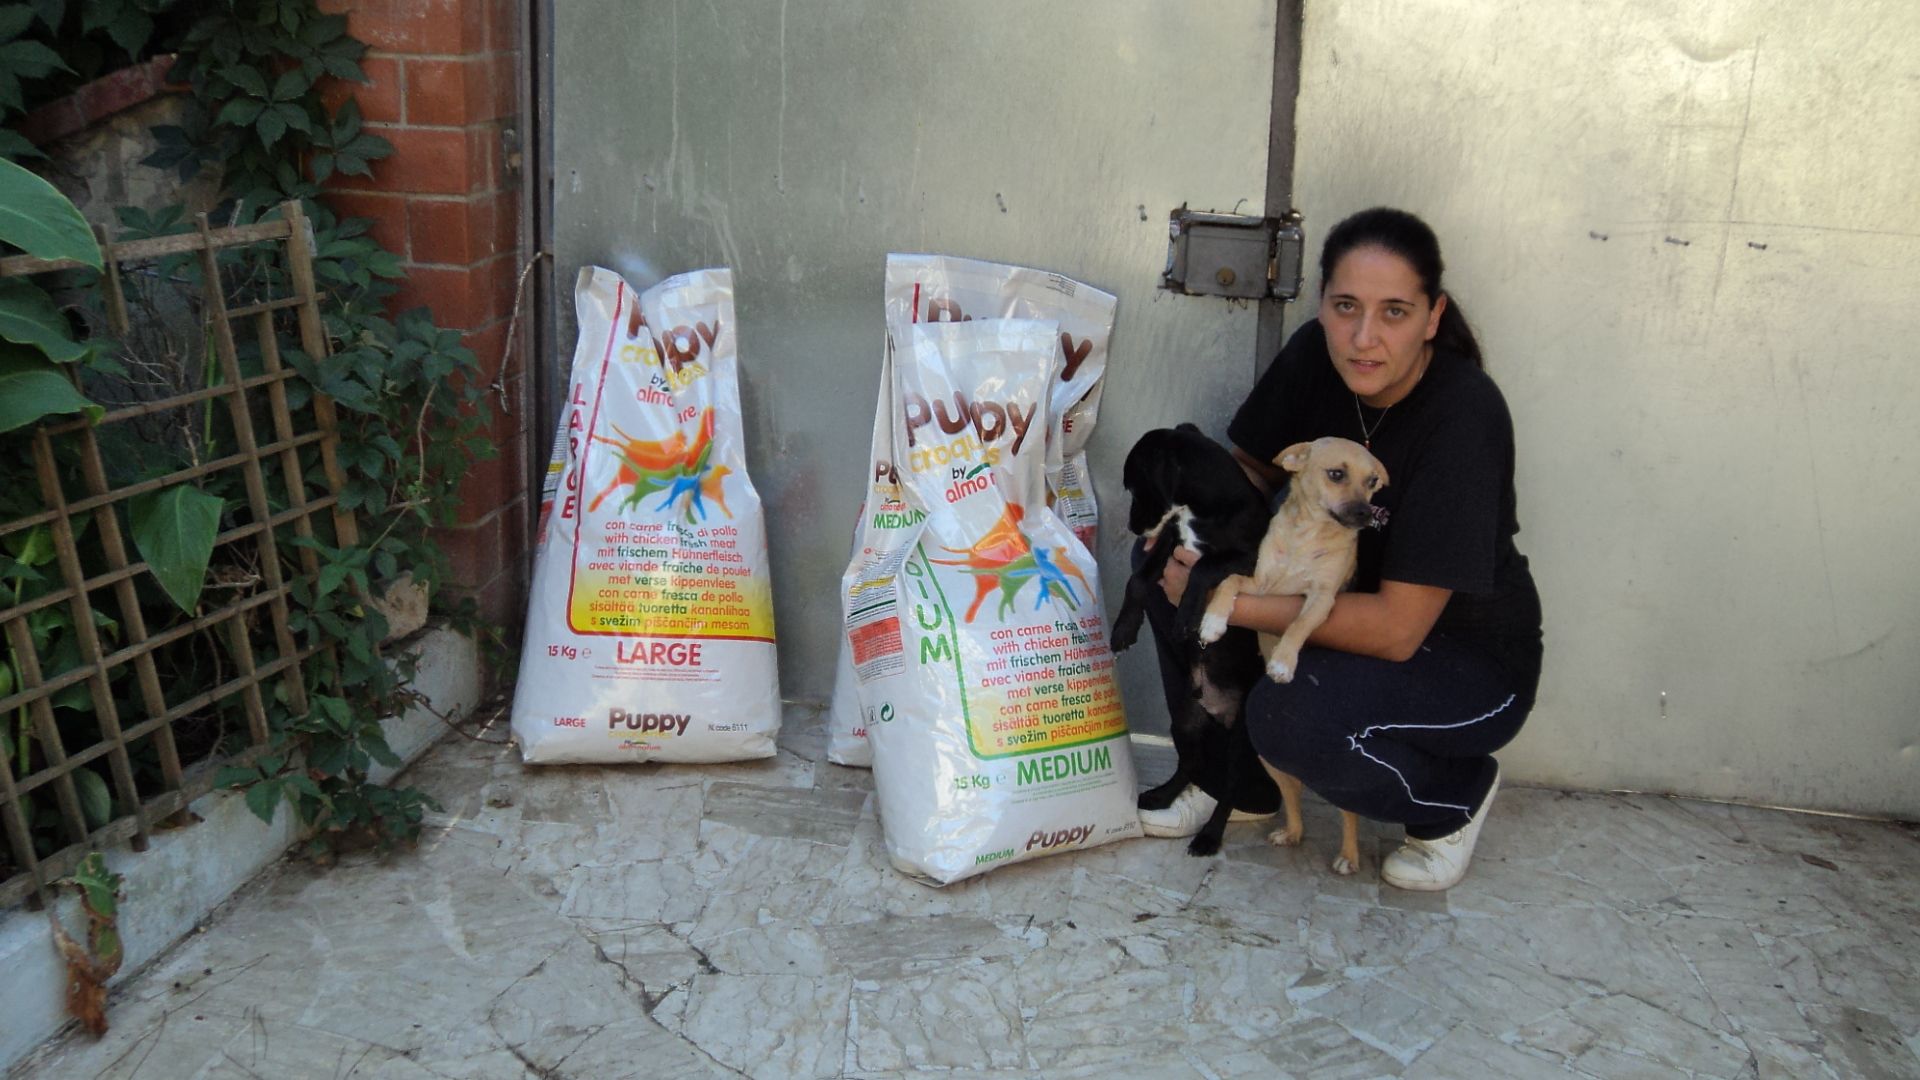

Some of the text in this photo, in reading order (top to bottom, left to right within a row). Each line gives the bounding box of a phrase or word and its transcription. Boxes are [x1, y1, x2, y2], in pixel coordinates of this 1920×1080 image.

[650, 373, 666, 387] by
[952, 466, 966, 479] by
[945, 475, 988, 503] almo
[605, 521, 625, 530] con
[630, 523, 663, 531] carne
[697, 528, 709, 538] di
[711, 525, 738, 538] pollo
[605, 532, 629, 543] with
[633, 533, 678, 545] chicken
[710, 540, 736, 549] meat
[597, 545, 743, 562] mit frischem Hühnerfleisch
[588, 562, 615, 571] avec
[619, 560, 658, 571] viande
[706, 563, 720, 574] de
[722, 565, 752, 578] poulet
[608, 573, 736, 590] met verse kippenvlees
[599, 588, 743, 604] con carne fresca de pollo
[639, 602, 687, 614] tuoretta
[690, 603, 750, 616] kananlihaa
[591, 617, 597, 625] s
[599, 614, 641, 626] svežim
[711, 620, 750, 630] mesom
[990, 629, 1013, 640] con
[1017, 624, 1052, 637] carne
[548, 645, 577, 660] 15 Kg
[617, 641, 702, 666] LARGE
[993, 640, 1020, 655] with
[1024, 636, 1069, 651] chicken
[987, 658, 1007, 671] mit
[1010, 652, 1062, 668] frischem
[981, 675, 1011, 687] avec
[1015, 667, 1055, 682] viande
[1007, 686, 1031, 699] met
[1034, 682, 1064, 695] verse
[1000, 704, 1022, 715] con
[1026, 699, 1058, 712] carne
[1061, 694, 1091, 707] fresca
[554, 717, 586, 728] LARGE
[609, 707, 691, 736] Puppy
[1043, 708, 1084, 725] tuoretta
[996, 737, 1003, 748] s
[1007, 730, 1048, 745] svežim
[1017, 746, 1112, 786] MEDIUM
[971, 774, 990, 789] Kg
[975, 848, 1014, 865] MEDIUM
[1026, 823, 1095, 851] Puppy
